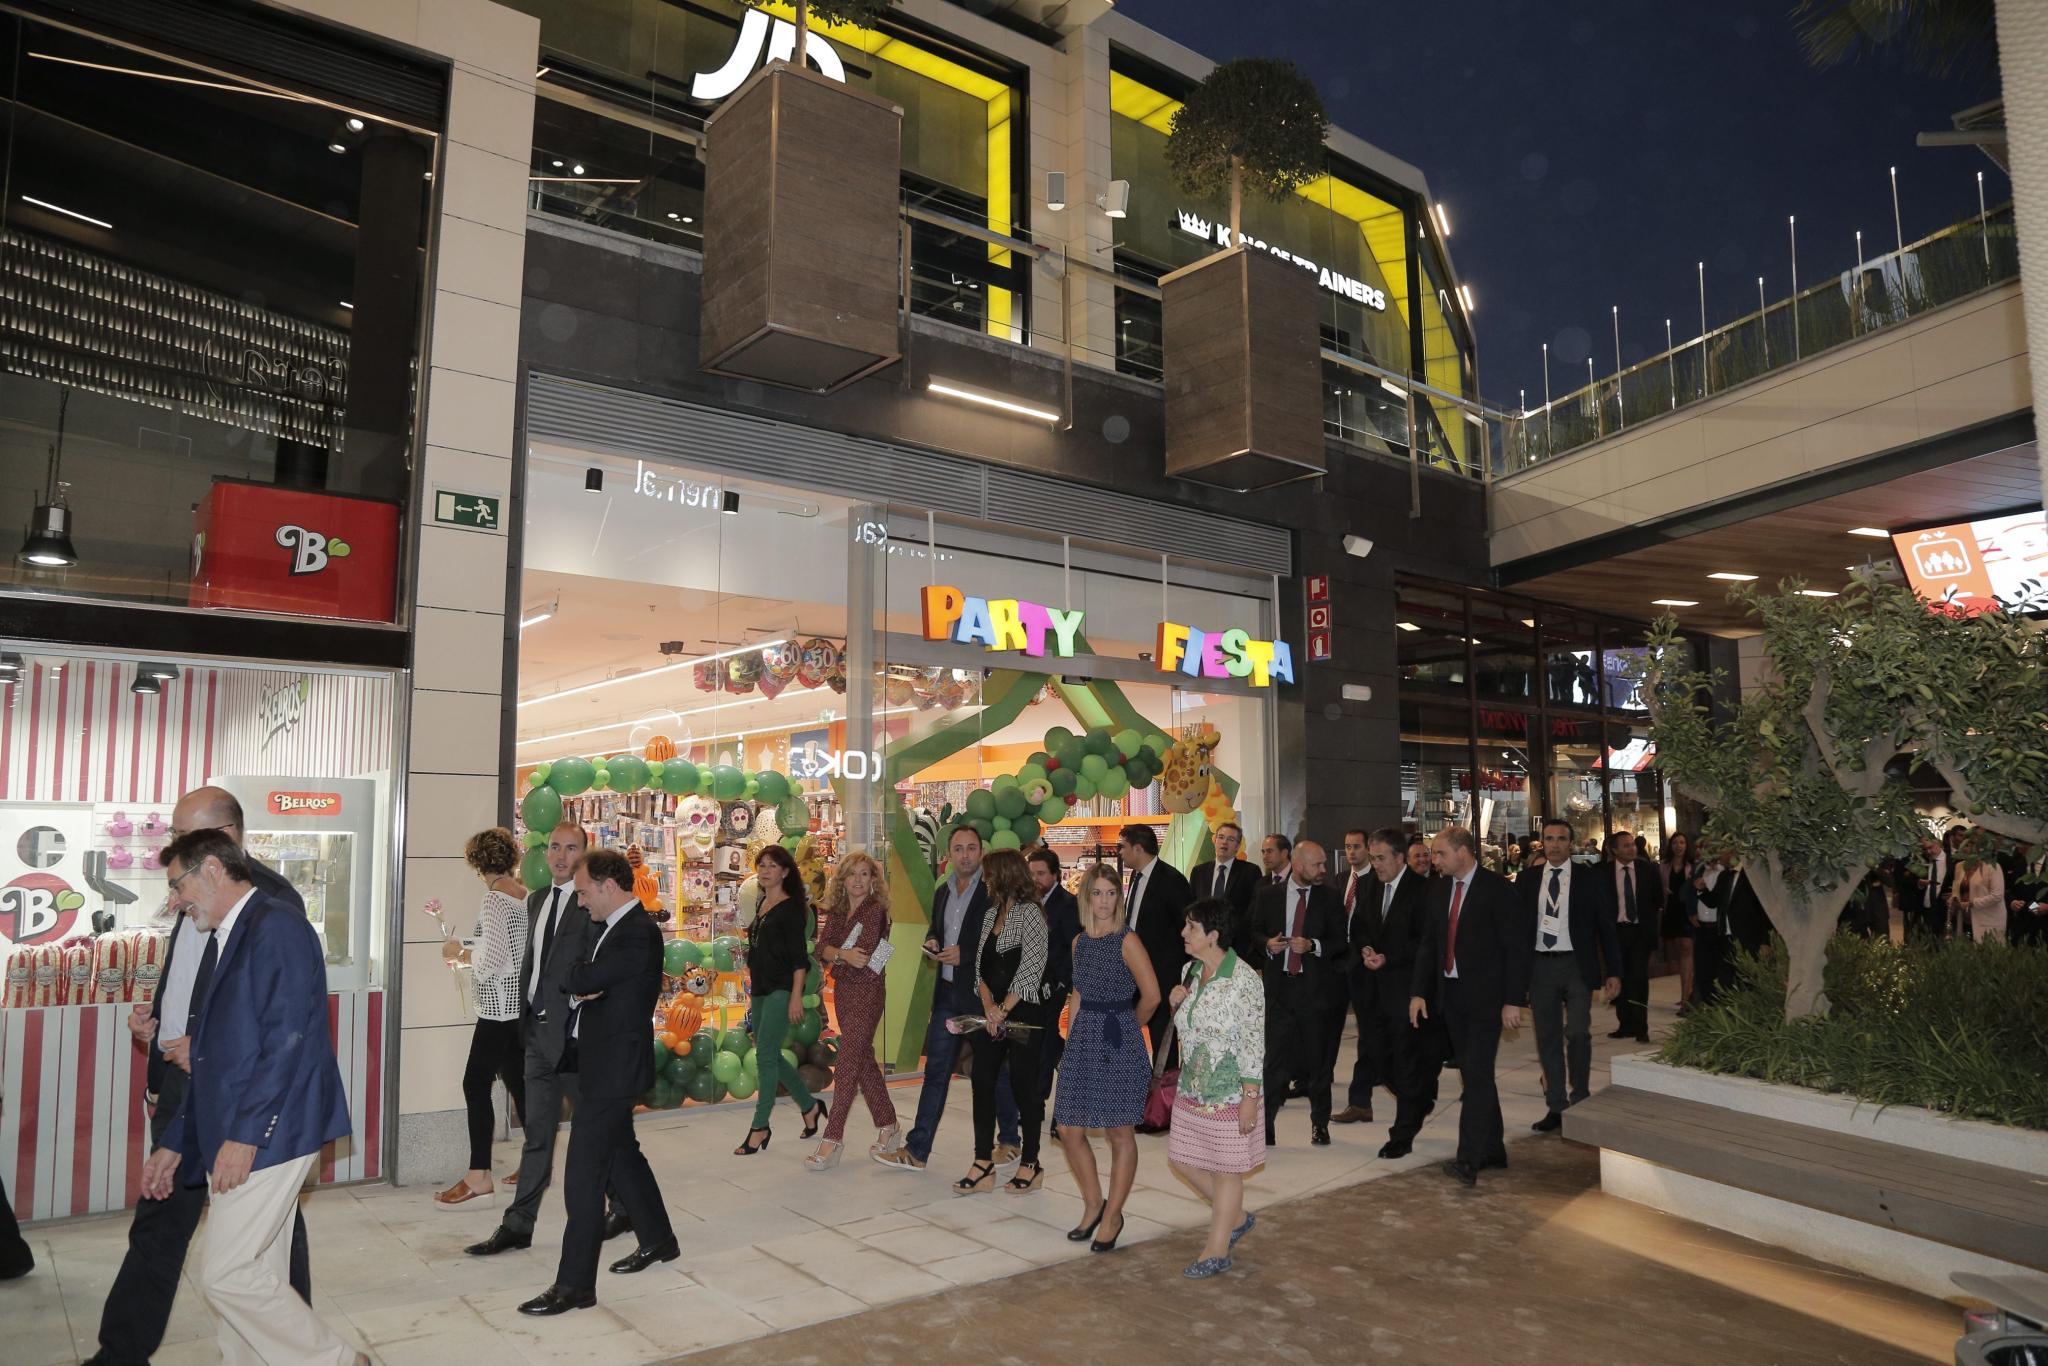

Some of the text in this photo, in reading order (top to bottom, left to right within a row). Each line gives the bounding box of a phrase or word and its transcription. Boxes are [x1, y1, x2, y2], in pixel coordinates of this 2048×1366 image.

[921, 584, 1294, 688] PARTY FIESTA
[781, 643, 800, 664] 60
[812, 649, 834, 668] 50
[274, 794, 327, 811] BELROS
